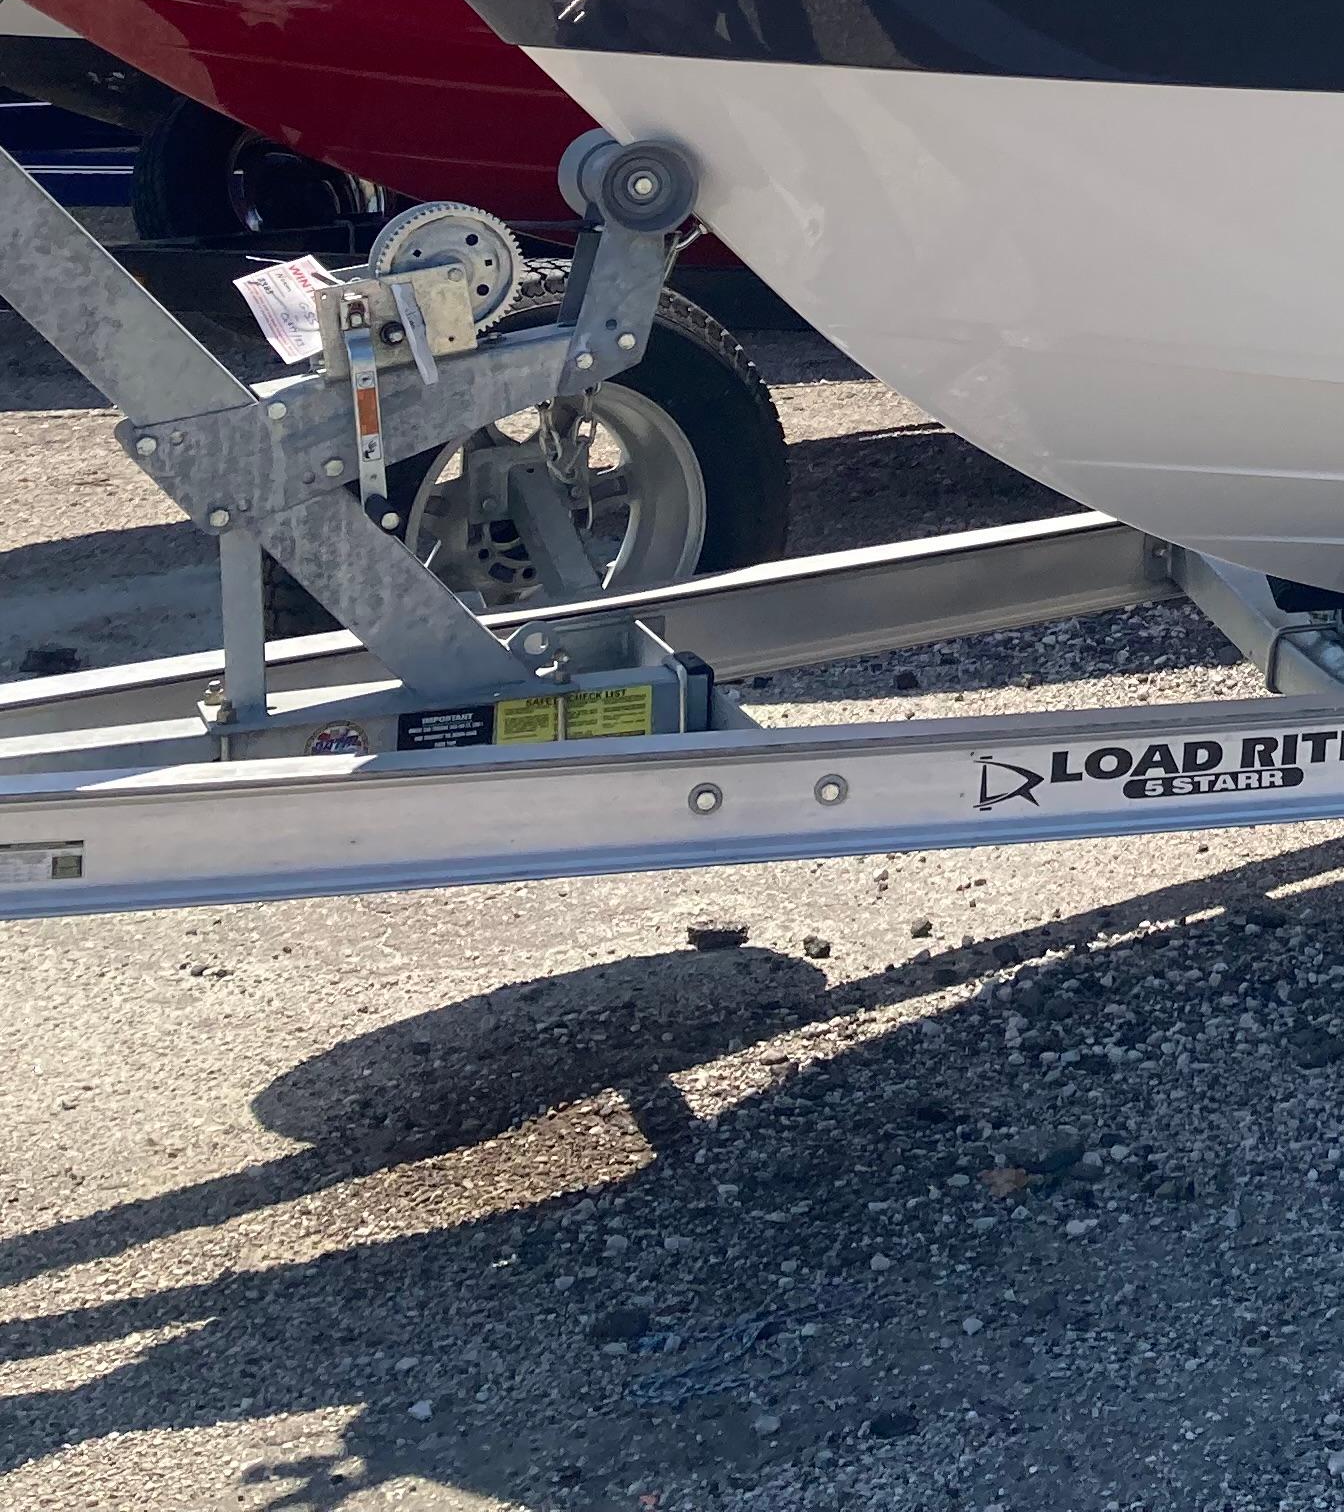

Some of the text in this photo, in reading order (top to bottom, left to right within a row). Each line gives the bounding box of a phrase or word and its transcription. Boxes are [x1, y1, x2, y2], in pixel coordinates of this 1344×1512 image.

[605, 688, 628, 698] LIST
[1050, 740, 1223, 783] LOAD
[1144, 770, 1284, 797] 5 STARR
